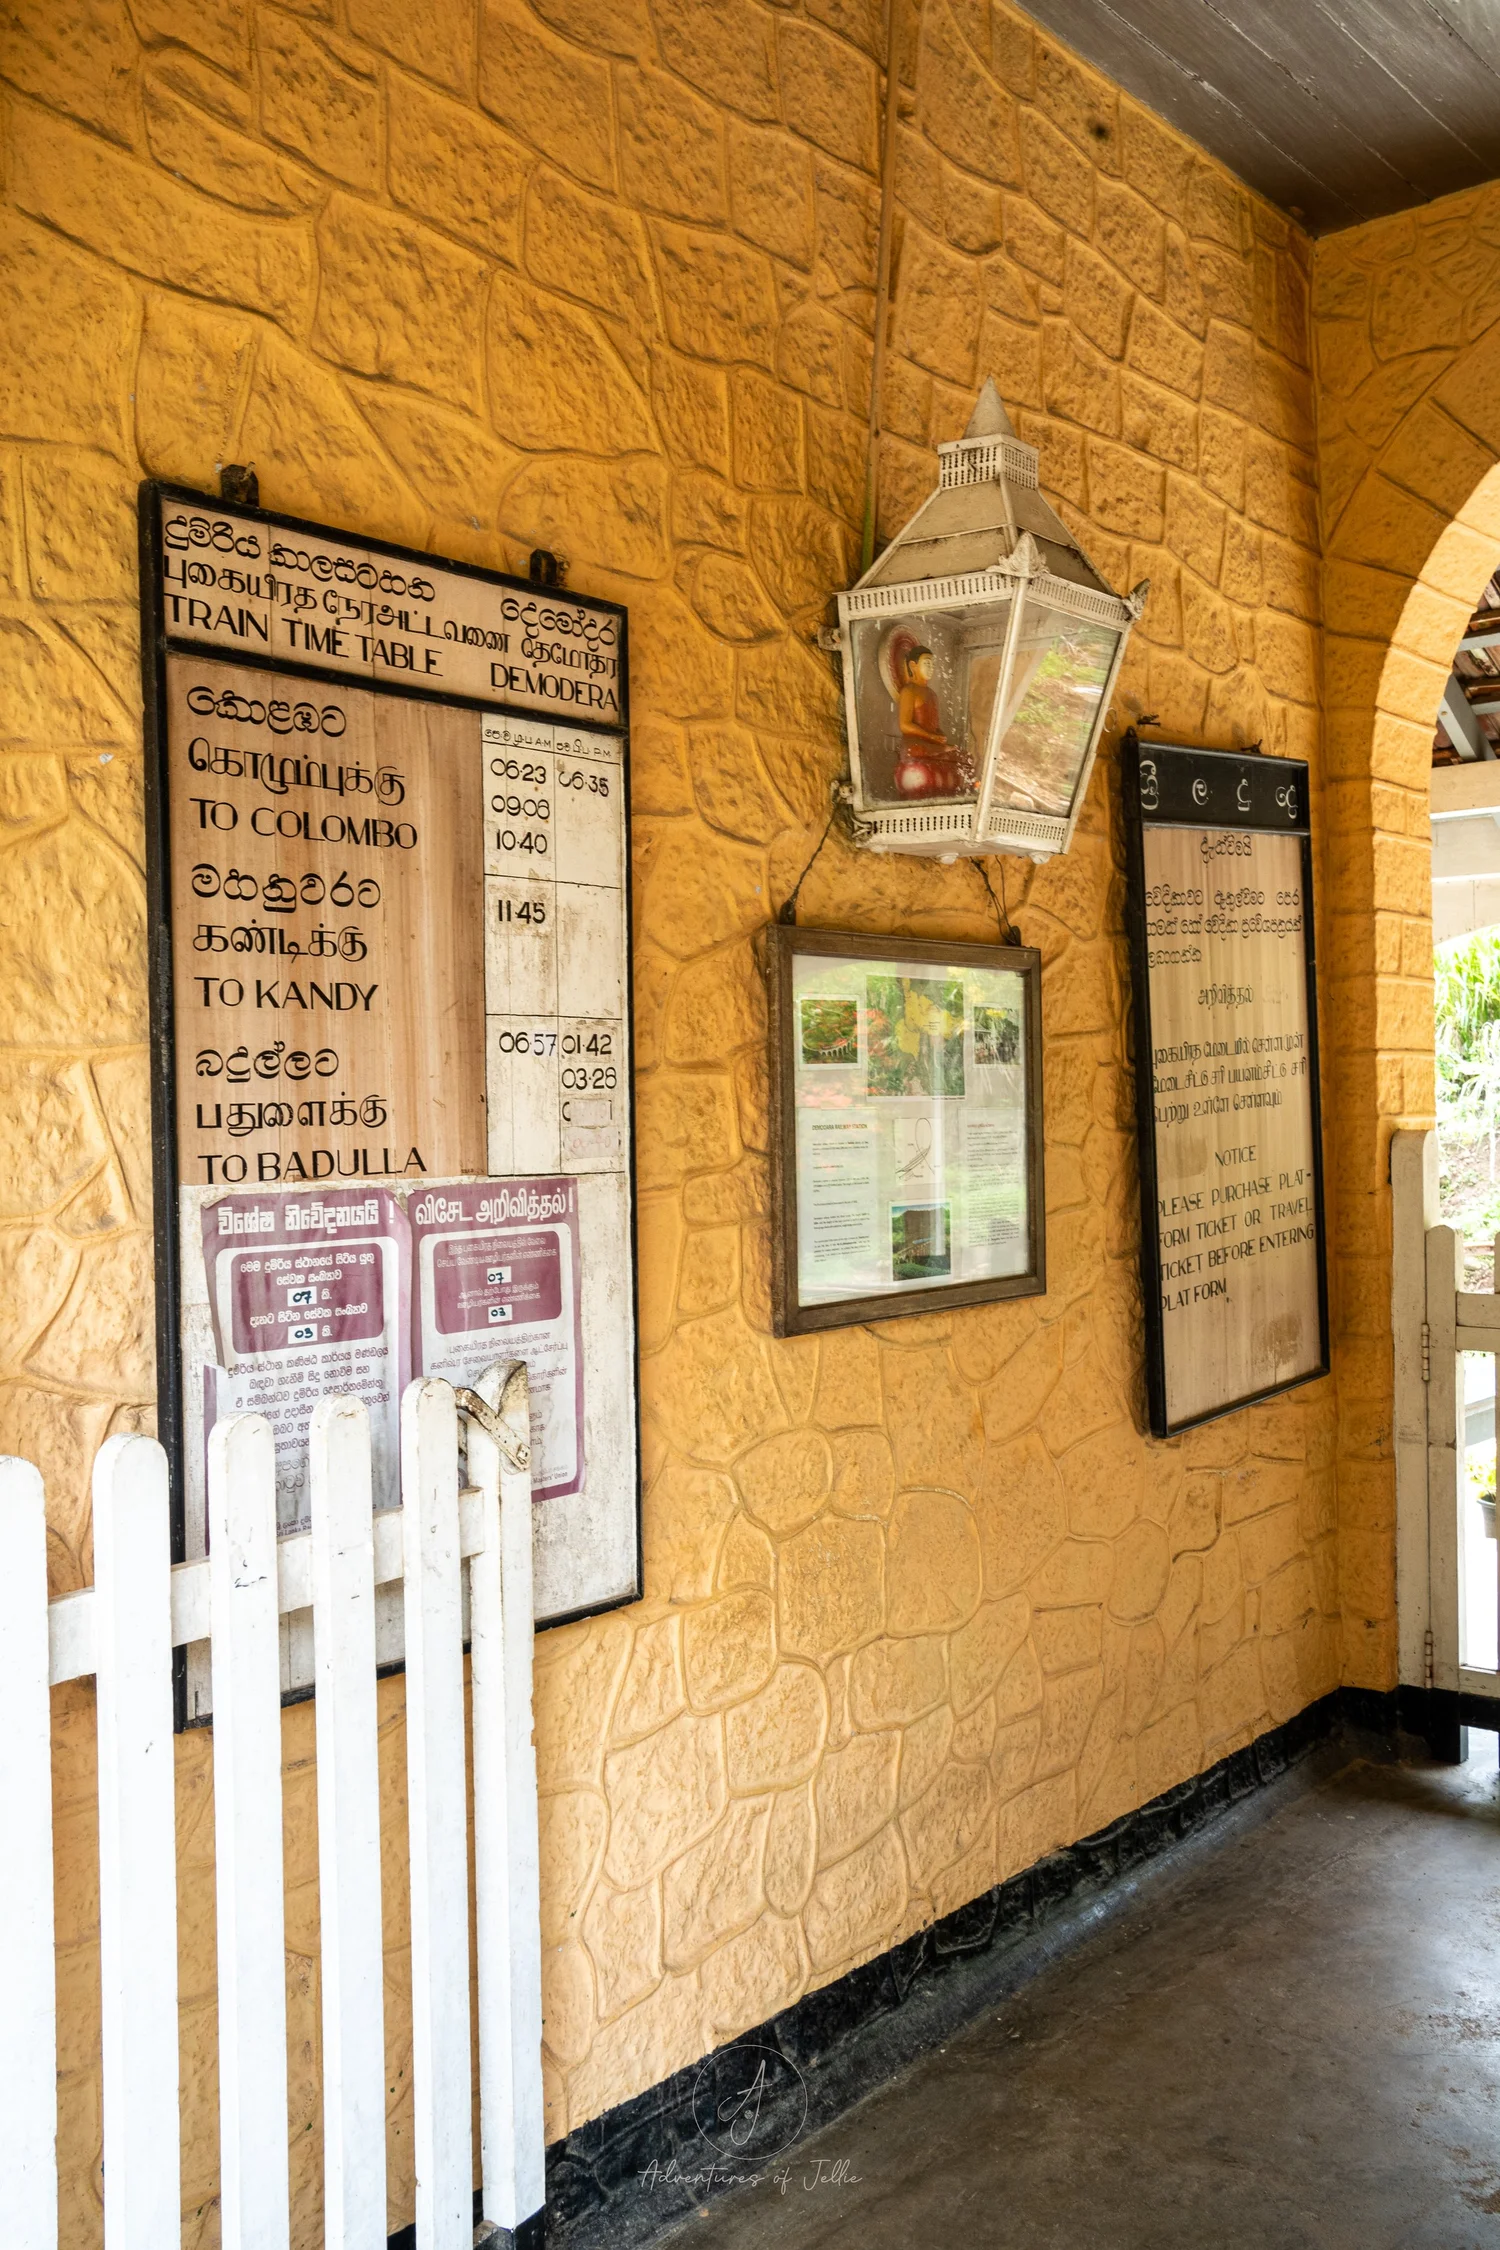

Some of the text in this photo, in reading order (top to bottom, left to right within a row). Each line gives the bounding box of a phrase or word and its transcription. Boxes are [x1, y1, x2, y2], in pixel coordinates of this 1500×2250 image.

[163, 593, 444, 677] TRAIN TIME TABLE
[500, 598, 616, 652] දෙමෝදර
[490, 662, 619, 713] DEMODERA
[188, 737, 406, 806] கொழும்புக்கு
[189, 797, 418, 849] TO COLOMBO
[191, 863, 382, 914] මහනුවරට
[192, 918, 368, 964] கண்டிக்கு
[193, 976, 380, 1012] TO KANDY
[195, 1040, 340, 1084] බදුල්ලට
[196, 1091, 388, 1138] பதுளைக்கு
[197, 1147, 428, 1185] TO BADULLA
[1215, 1145, 1257, 1167] NOTICE
[415, 1194, 473, 1225] விசேட
[475, 1187, 566, 1224] அறிவித்தல்
[1157, 1192, 1205, 1217] PLEASE
[1212, 1176, 1273, 1206] PURCHASE
[1158, 1196, 1313, 1249] FORM TICKET OR TRAVEL
[1160, 1223, 1315, 1282] TICKET BEFORE ENTERING
[292, 1290, 313, 1305] 07
[488, 1272, 504, 1285] 07
[294, 1327, 314, 1339] 03
[491, 1306, 506, 1317] 03
